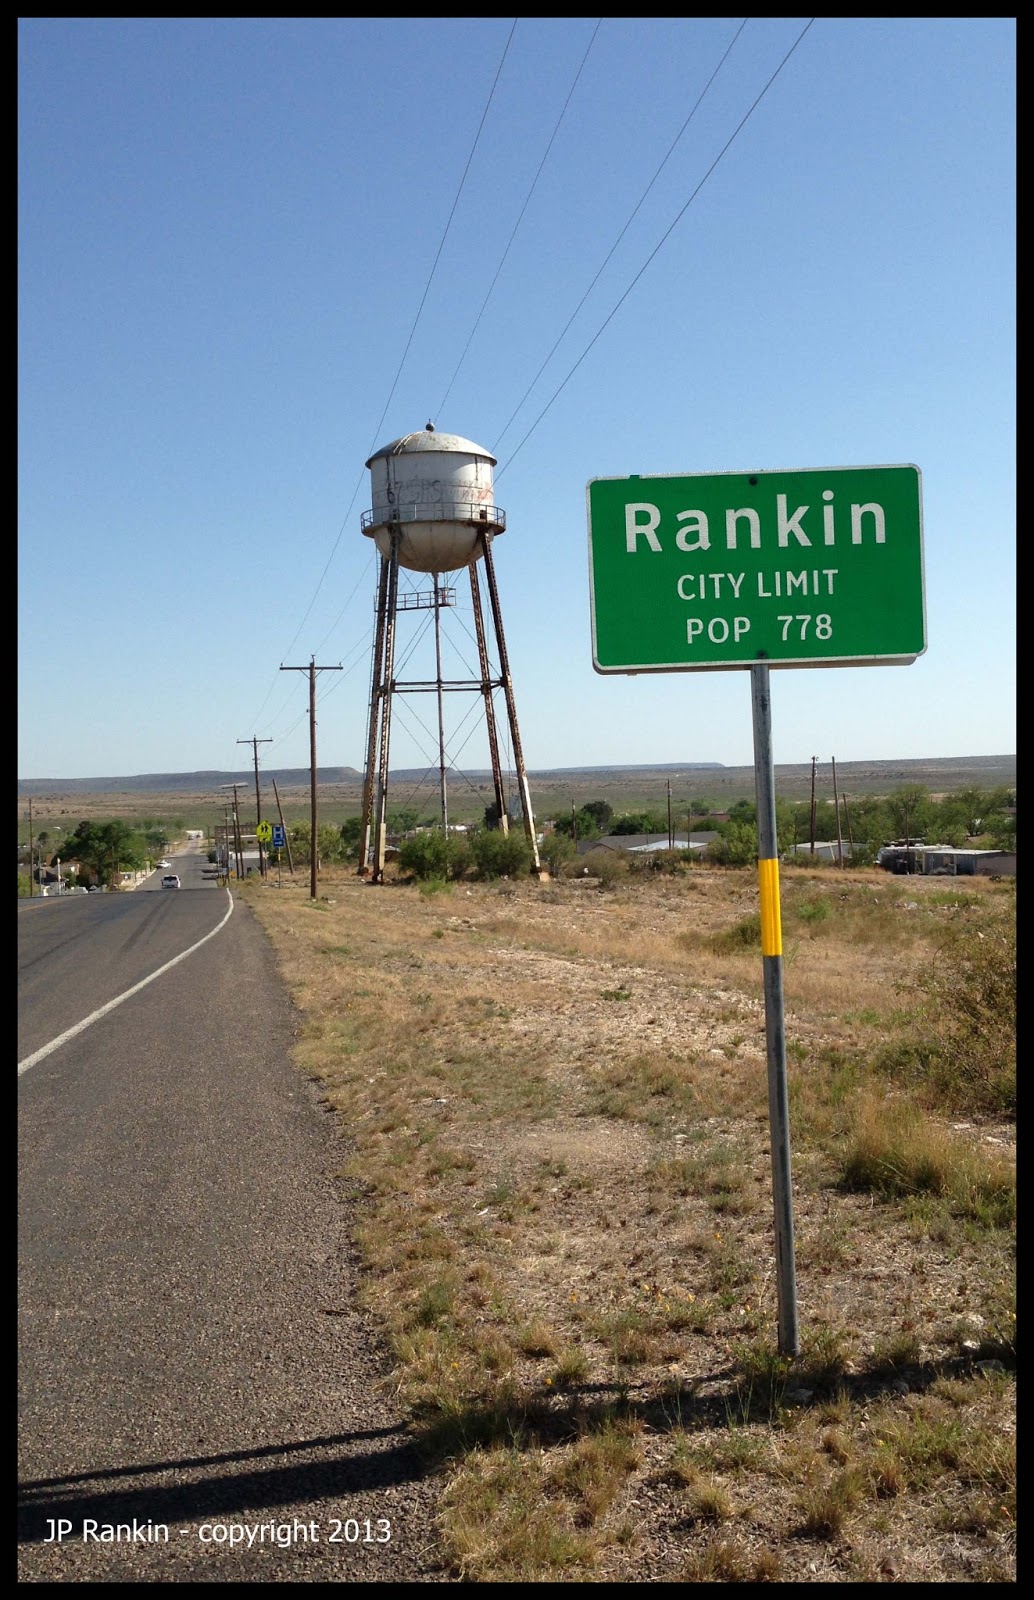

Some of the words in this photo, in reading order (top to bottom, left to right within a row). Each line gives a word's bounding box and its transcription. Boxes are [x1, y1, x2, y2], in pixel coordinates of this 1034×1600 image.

[624, 489, 887, 553] Rankin
[677, 572, 745, 600] CITY
[757, 568, 839, 598] LIMIT
[686, 616, 751, 644] POP
[777, 613, 833, 641] 778
[273, 827, 283, 839] H
